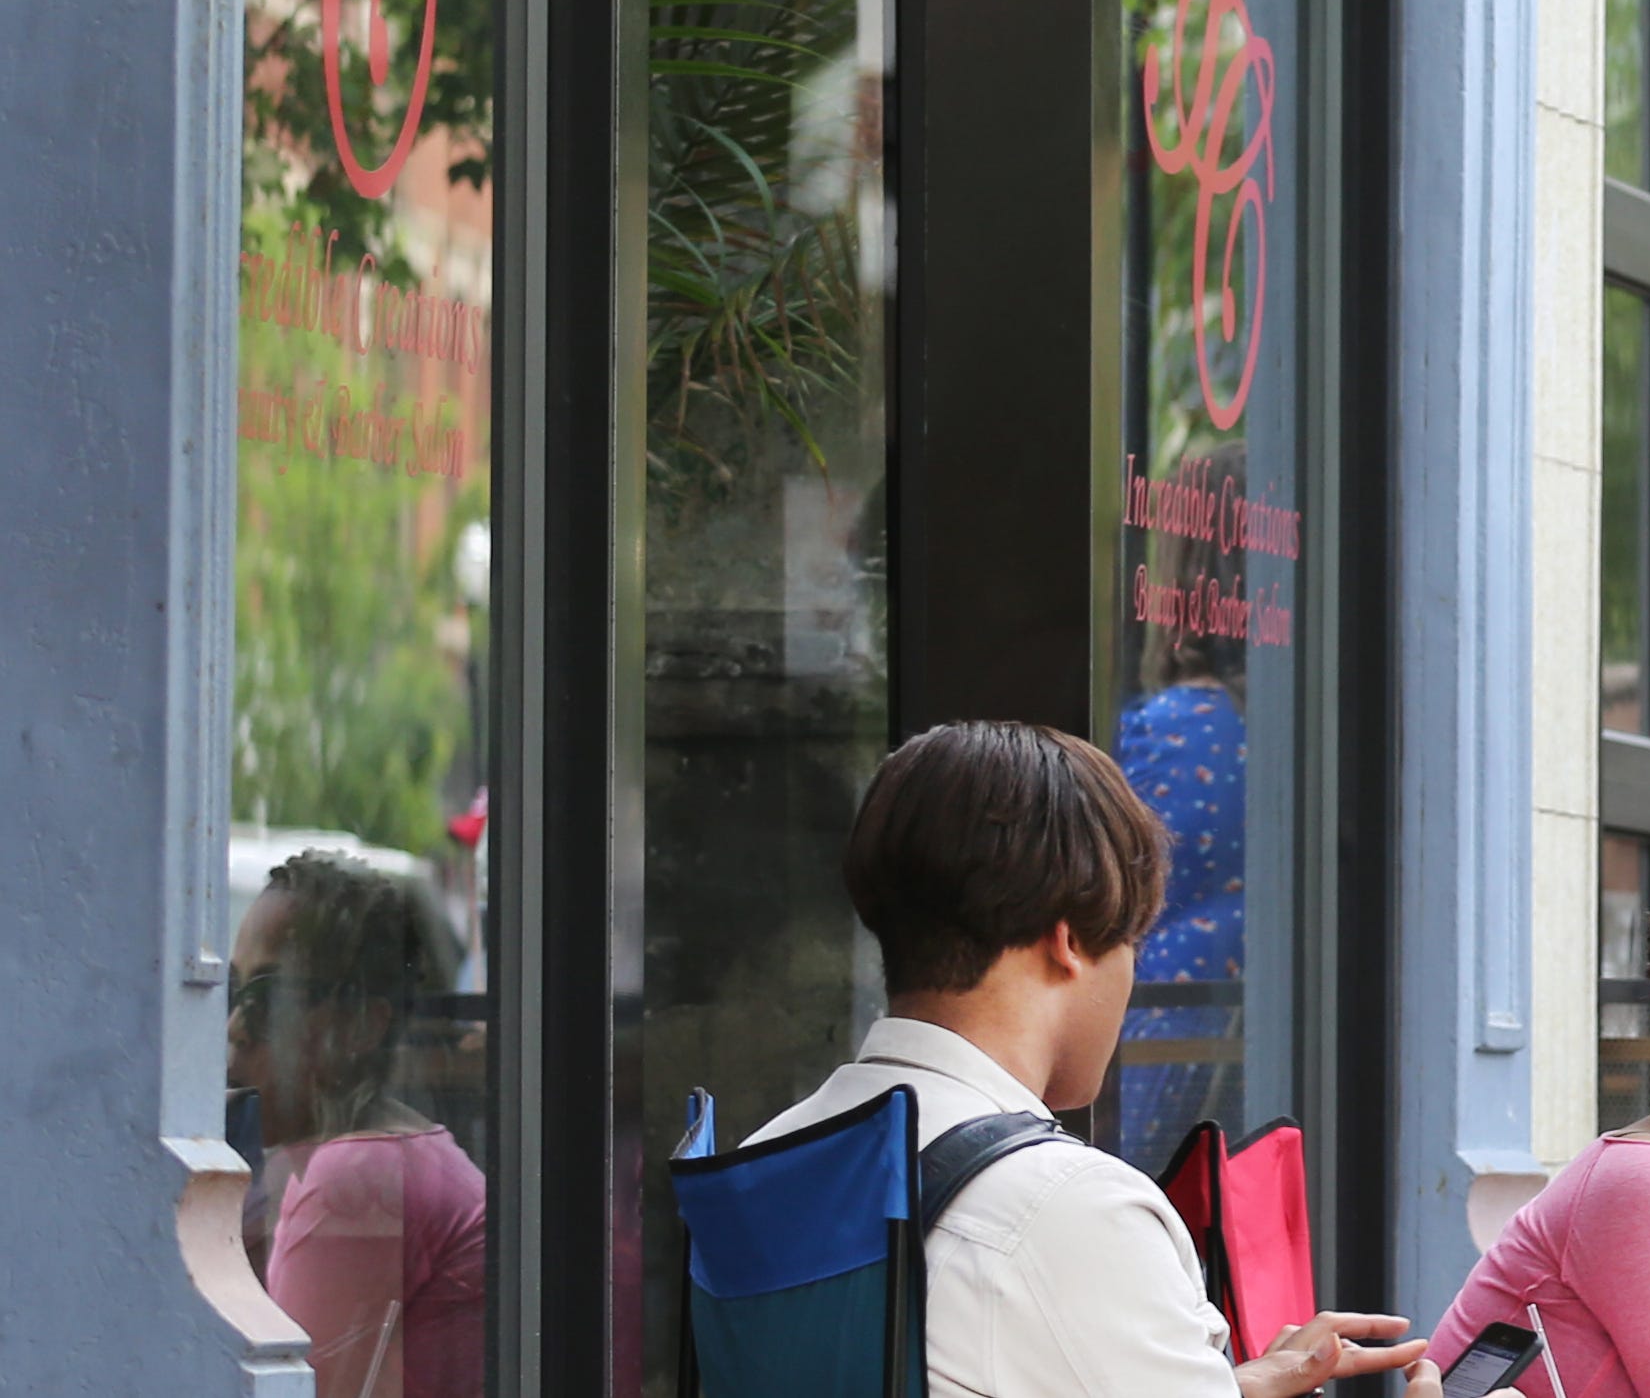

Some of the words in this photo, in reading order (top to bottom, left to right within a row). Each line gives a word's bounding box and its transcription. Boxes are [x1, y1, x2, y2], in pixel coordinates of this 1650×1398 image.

[239, 220, 350, 338] redible
[354, 252, 481, 375] Creations
[330, 384, 406, 465] Barber
[405, 394, 466, 479] Salon
[1123, 453, 1216, 543] Incredible
[1218, 475, 1302, 561] Creations
[1133, 563, 1186, 651] Beauty
[1188, 566, 1206, 638] &
[1206, 577, 1253, 640] Barber
[1253, 582, 1292, 647] Salon
